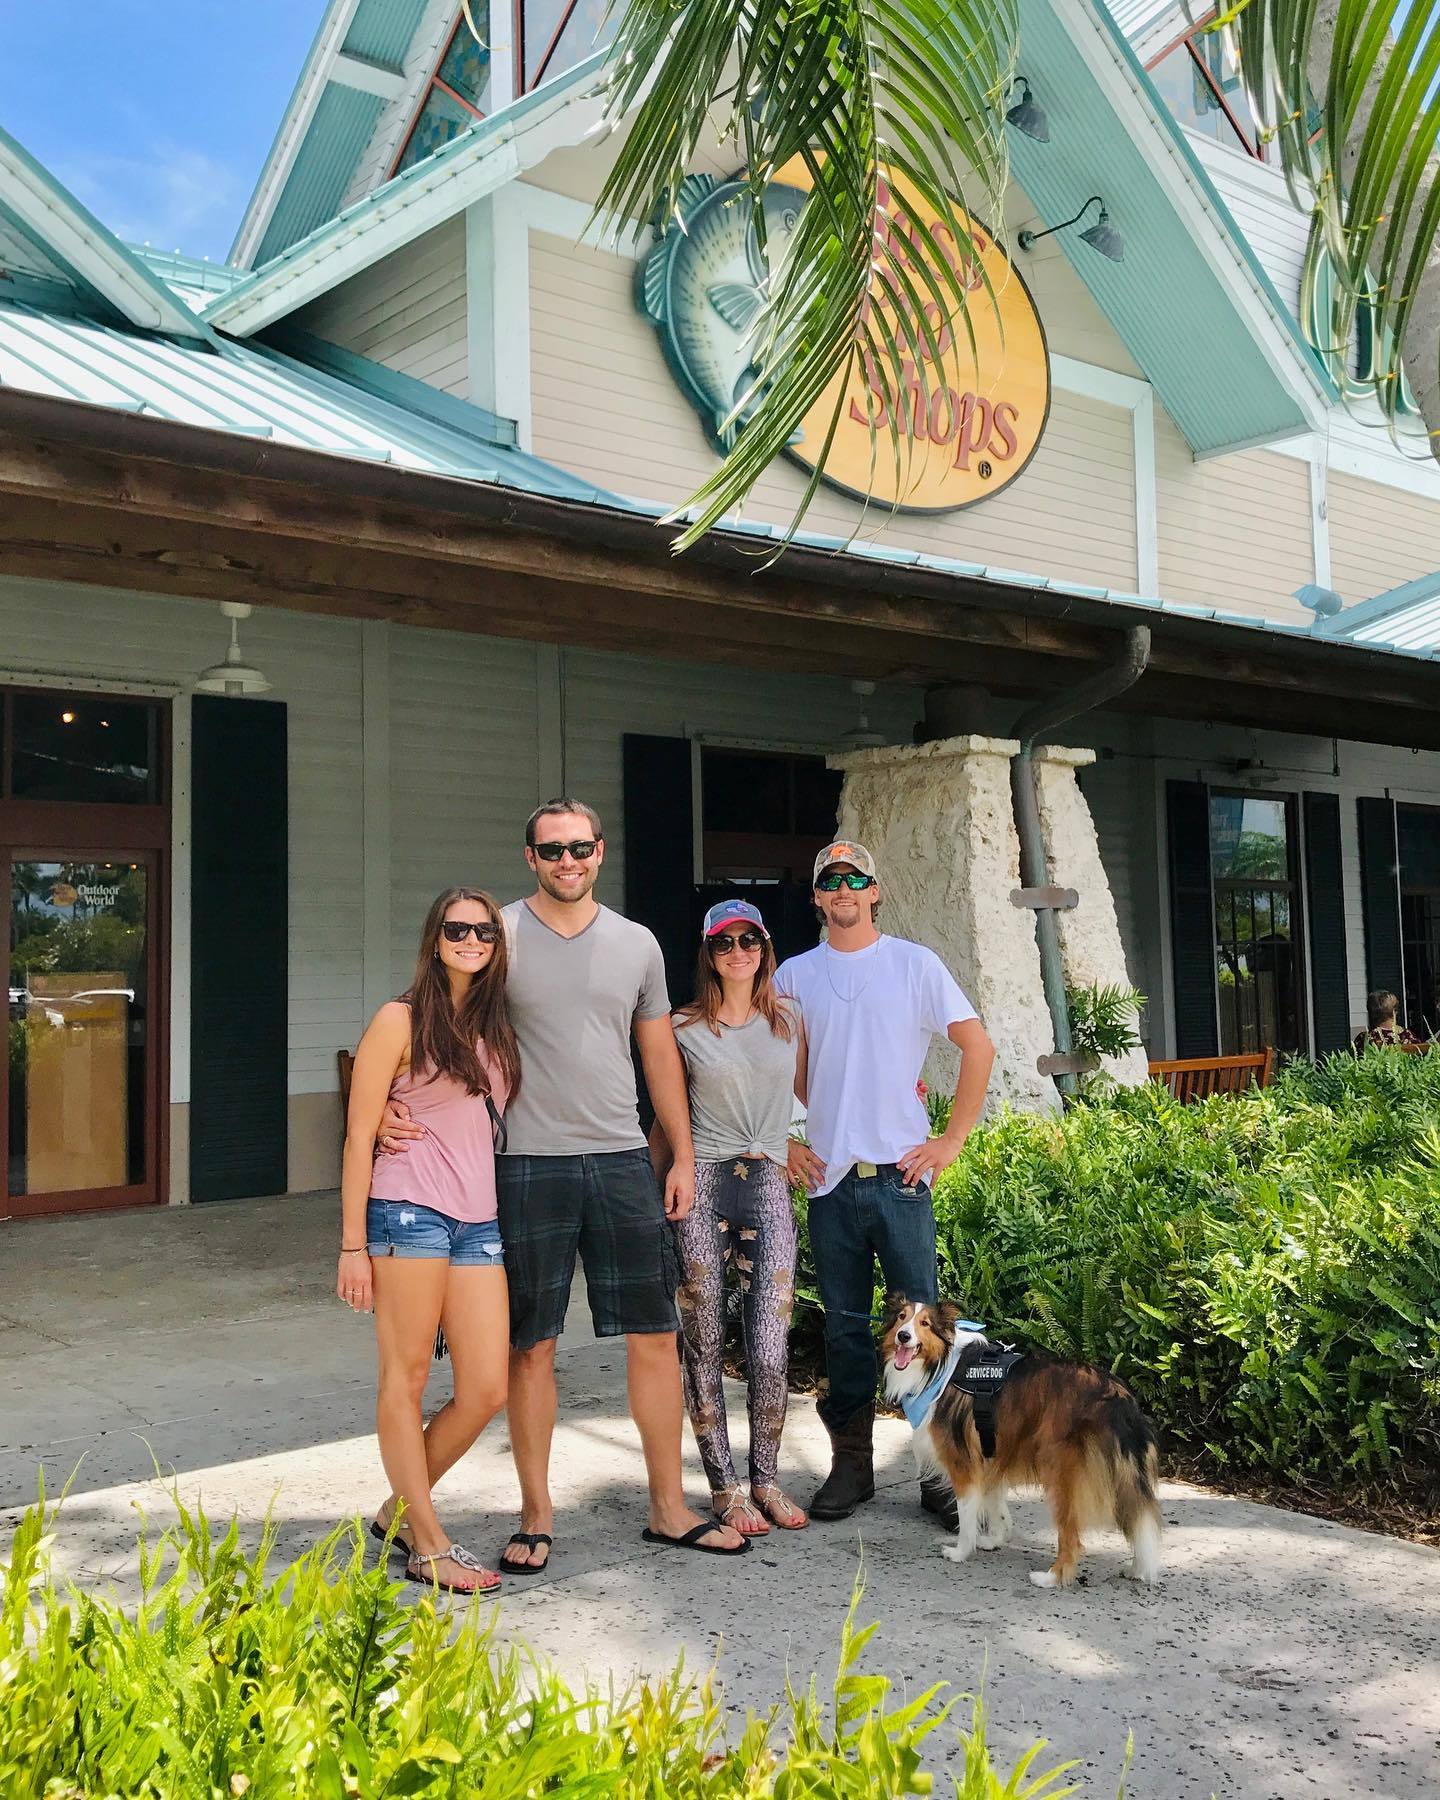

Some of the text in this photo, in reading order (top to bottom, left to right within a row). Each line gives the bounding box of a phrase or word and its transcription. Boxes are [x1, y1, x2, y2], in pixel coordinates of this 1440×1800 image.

[849, 344, 1020, 472] Shops
[78, 884, 120, 896] Outdoor
[84, 895, 115, 906] World
[965, 1367, 1003, 1379] SERVICE DOG
